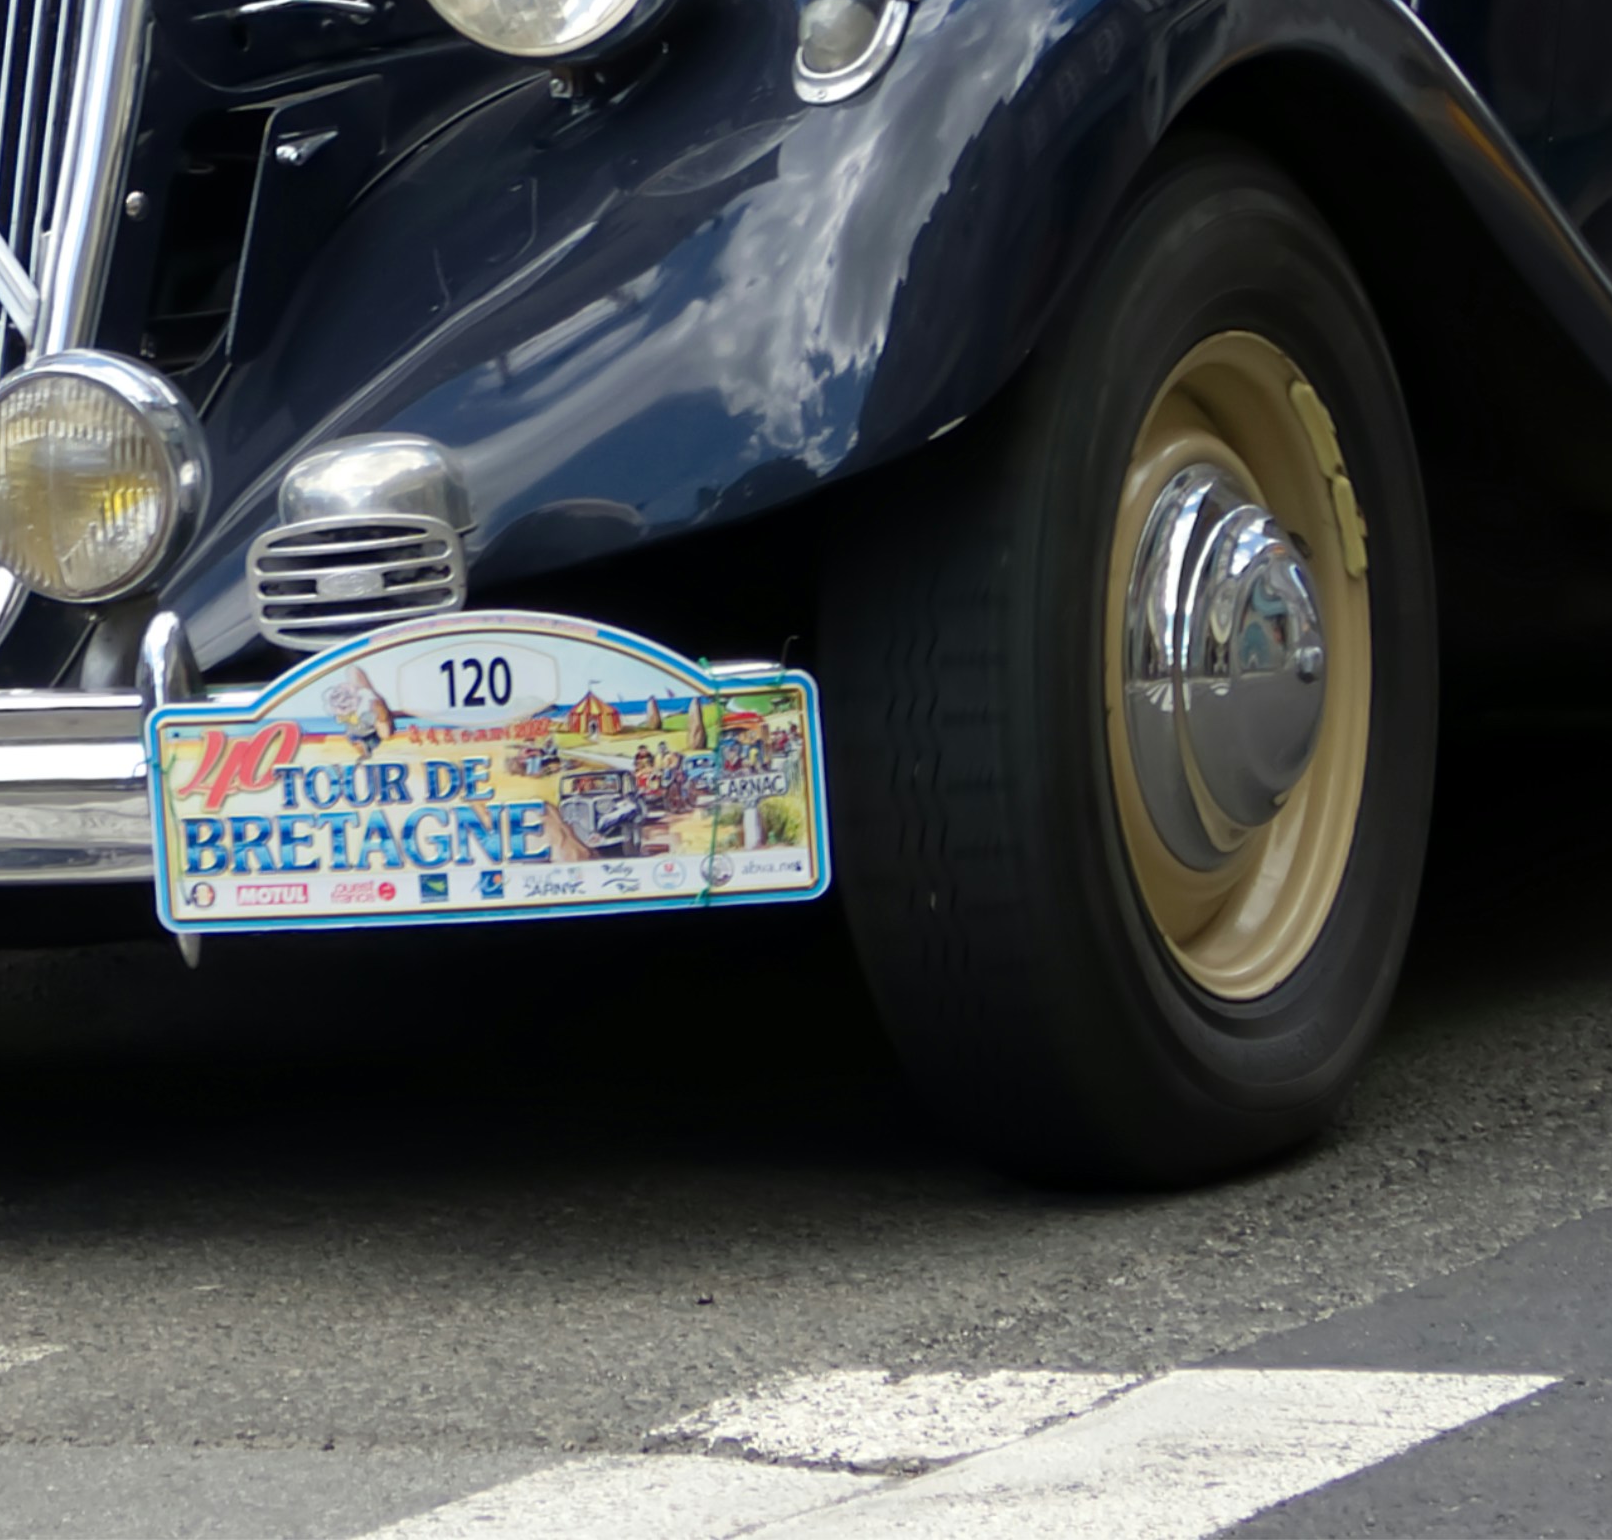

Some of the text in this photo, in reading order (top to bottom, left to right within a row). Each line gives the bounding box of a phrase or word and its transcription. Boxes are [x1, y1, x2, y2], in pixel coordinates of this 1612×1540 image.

[440, 657, 513, 708] 120
[177, 722, 301, 811] 40
[273, 757, 495, 810] TOUR DE
[181, 799, 552, 876] BRETAGNE
[240, 885, 307, 903] MOTUL
